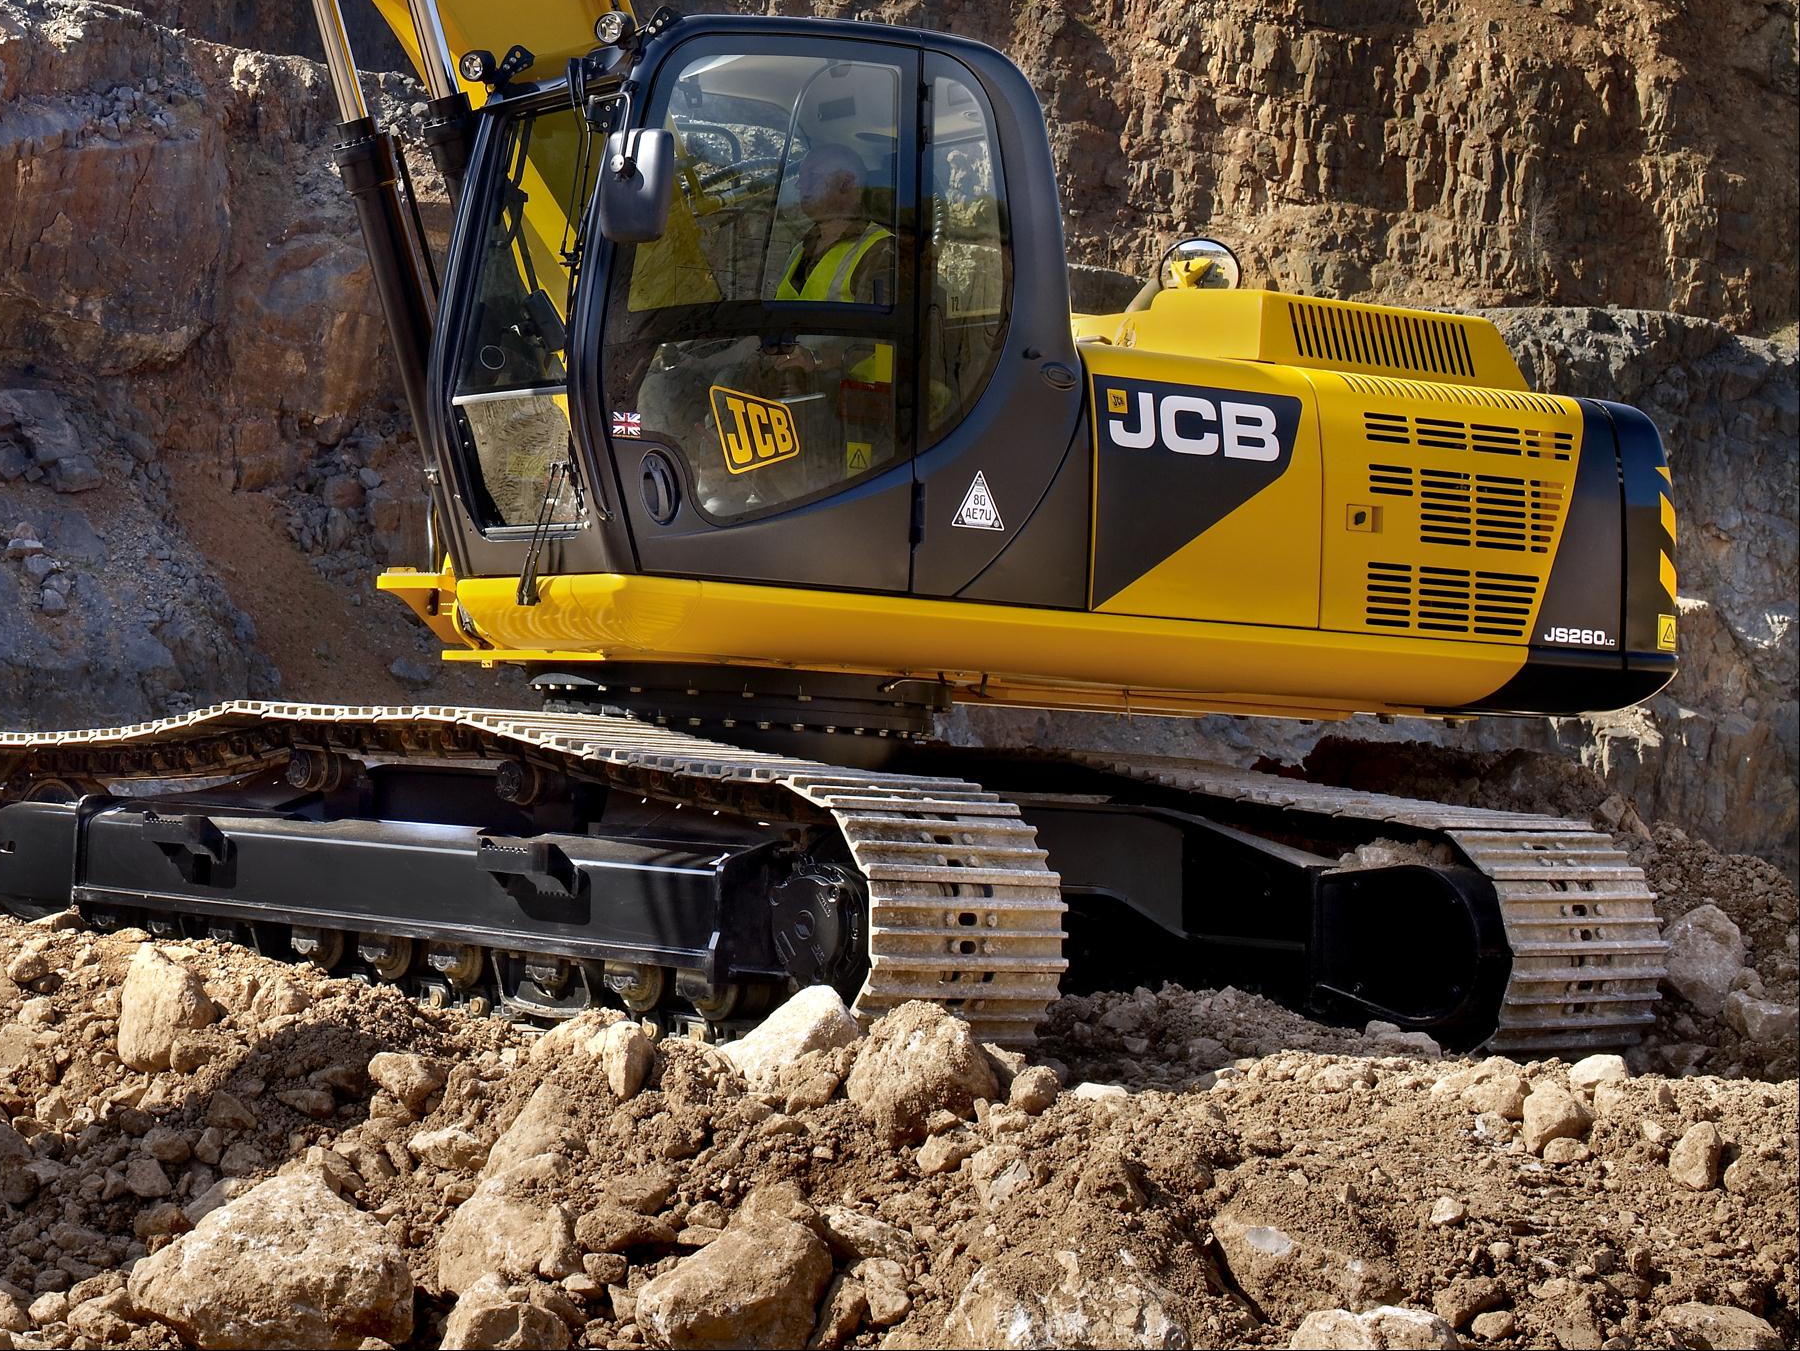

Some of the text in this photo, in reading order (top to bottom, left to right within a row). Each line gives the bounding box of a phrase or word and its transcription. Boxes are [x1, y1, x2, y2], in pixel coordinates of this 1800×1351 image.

[725, 395, 796, 466] JCB
[1108, 391, 1281, 463] JCB
[965, 507, 992, 521] AE7U
[1544, 627, 1605, 645] JS260
